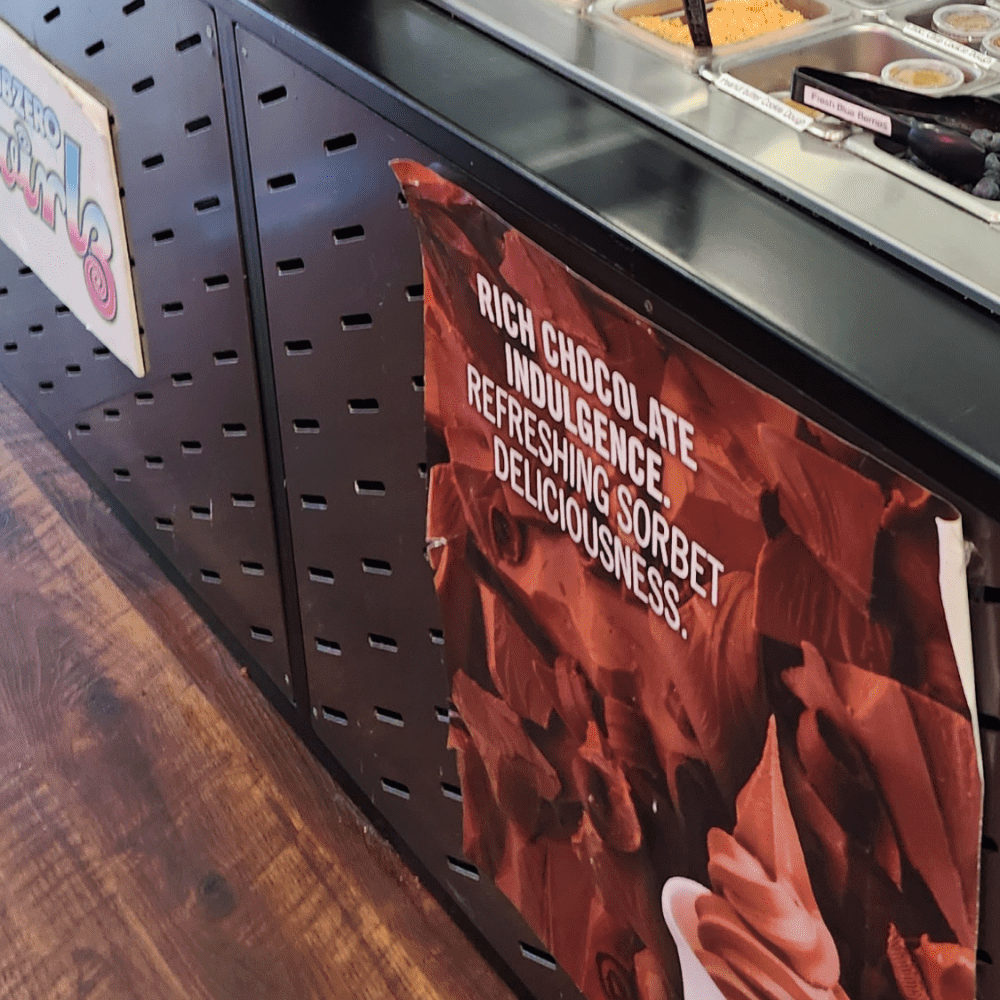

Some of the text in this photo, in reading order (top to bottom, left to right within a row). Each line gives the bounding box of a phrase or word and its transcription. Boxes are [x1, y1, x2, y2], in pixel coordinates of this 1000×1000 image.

[811, 91, 835, 109] Fresh
[475, 273, 698, 473] RICH CHOCOLATE
[504, 342, 671, 509] INDULGENCE.
[466, 362, 725, 609] REFRESHING SORBET
[493, 434, 689, 641] DELICIOUSNESS.
